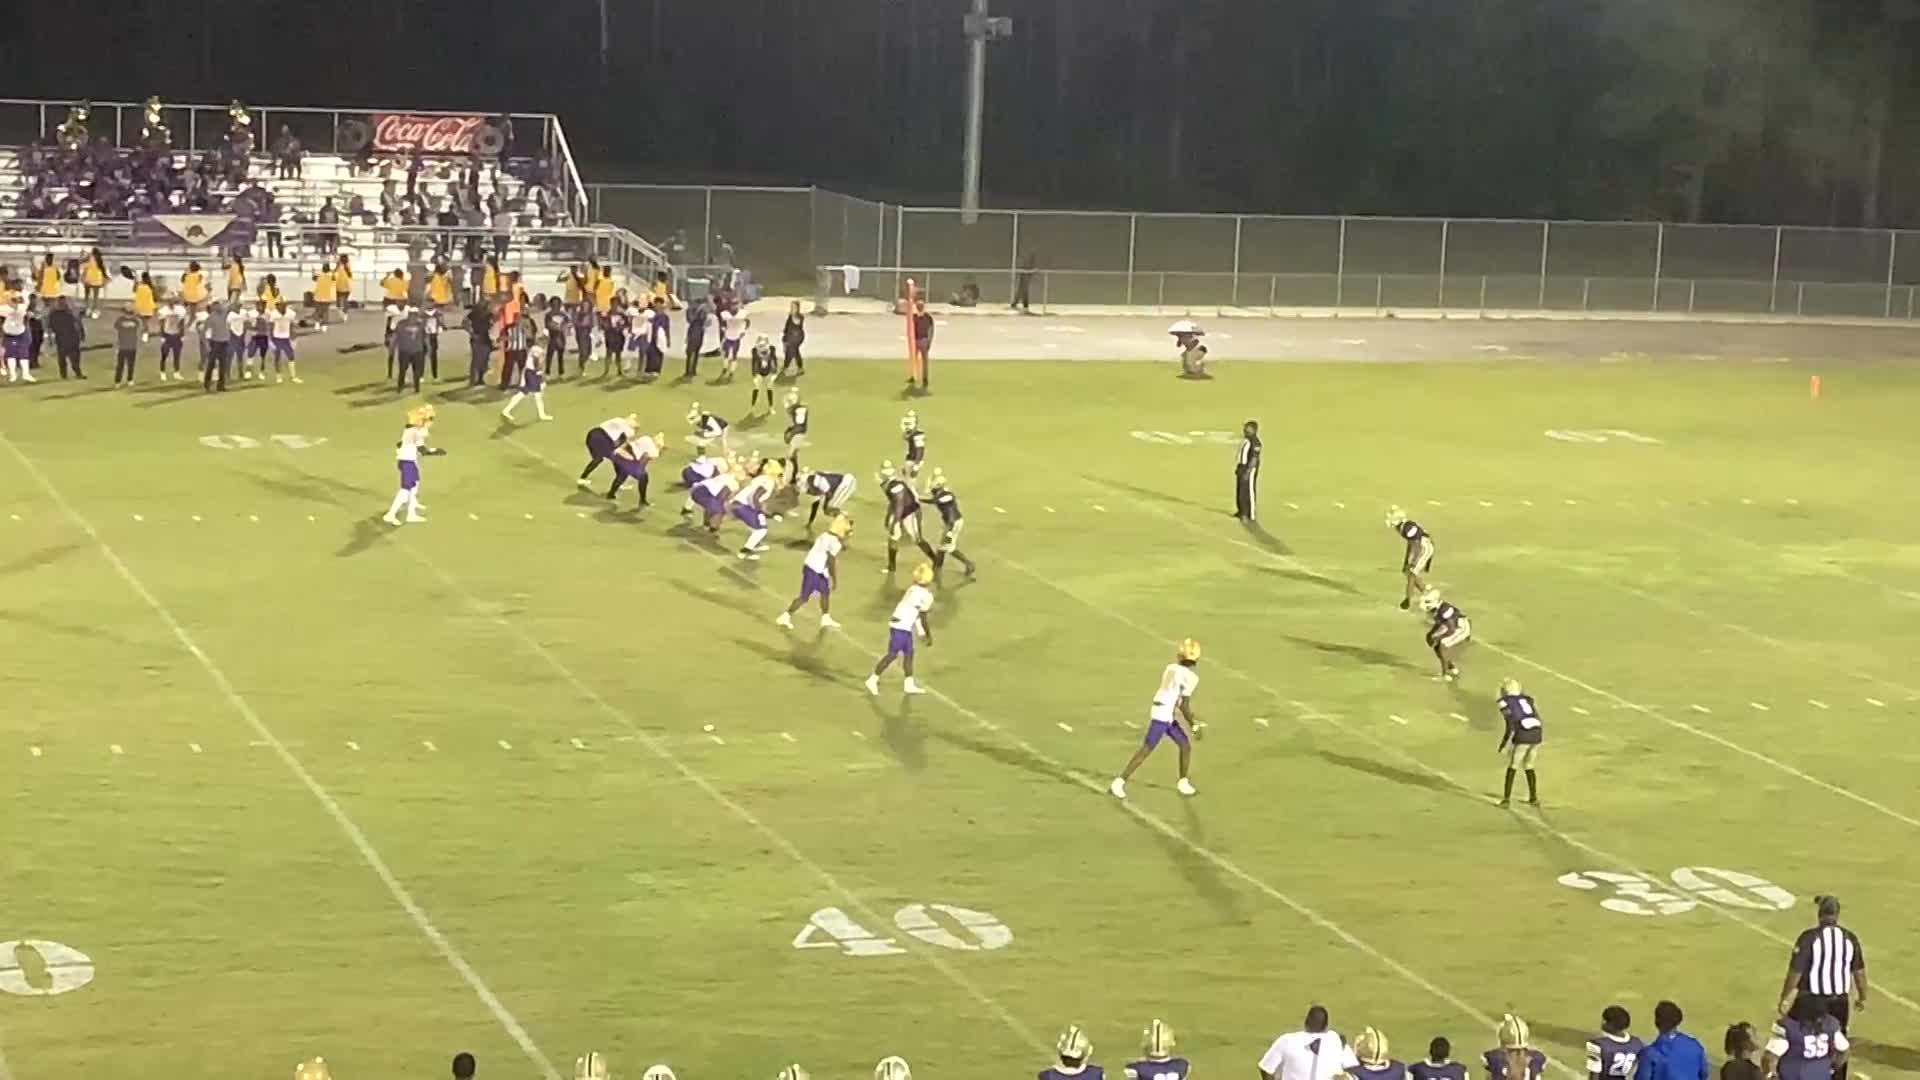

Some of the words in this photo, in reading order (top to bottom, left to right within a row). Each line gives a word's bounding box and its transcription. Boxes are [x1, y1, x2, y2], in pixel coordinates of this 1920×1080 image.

[374, 115, 481, 152] Coca-Cola
[1557, 867, 1796, 915] 30
[792, 903, 1013, 955] 40
[1803, 1033, 1829, 1058] 55
